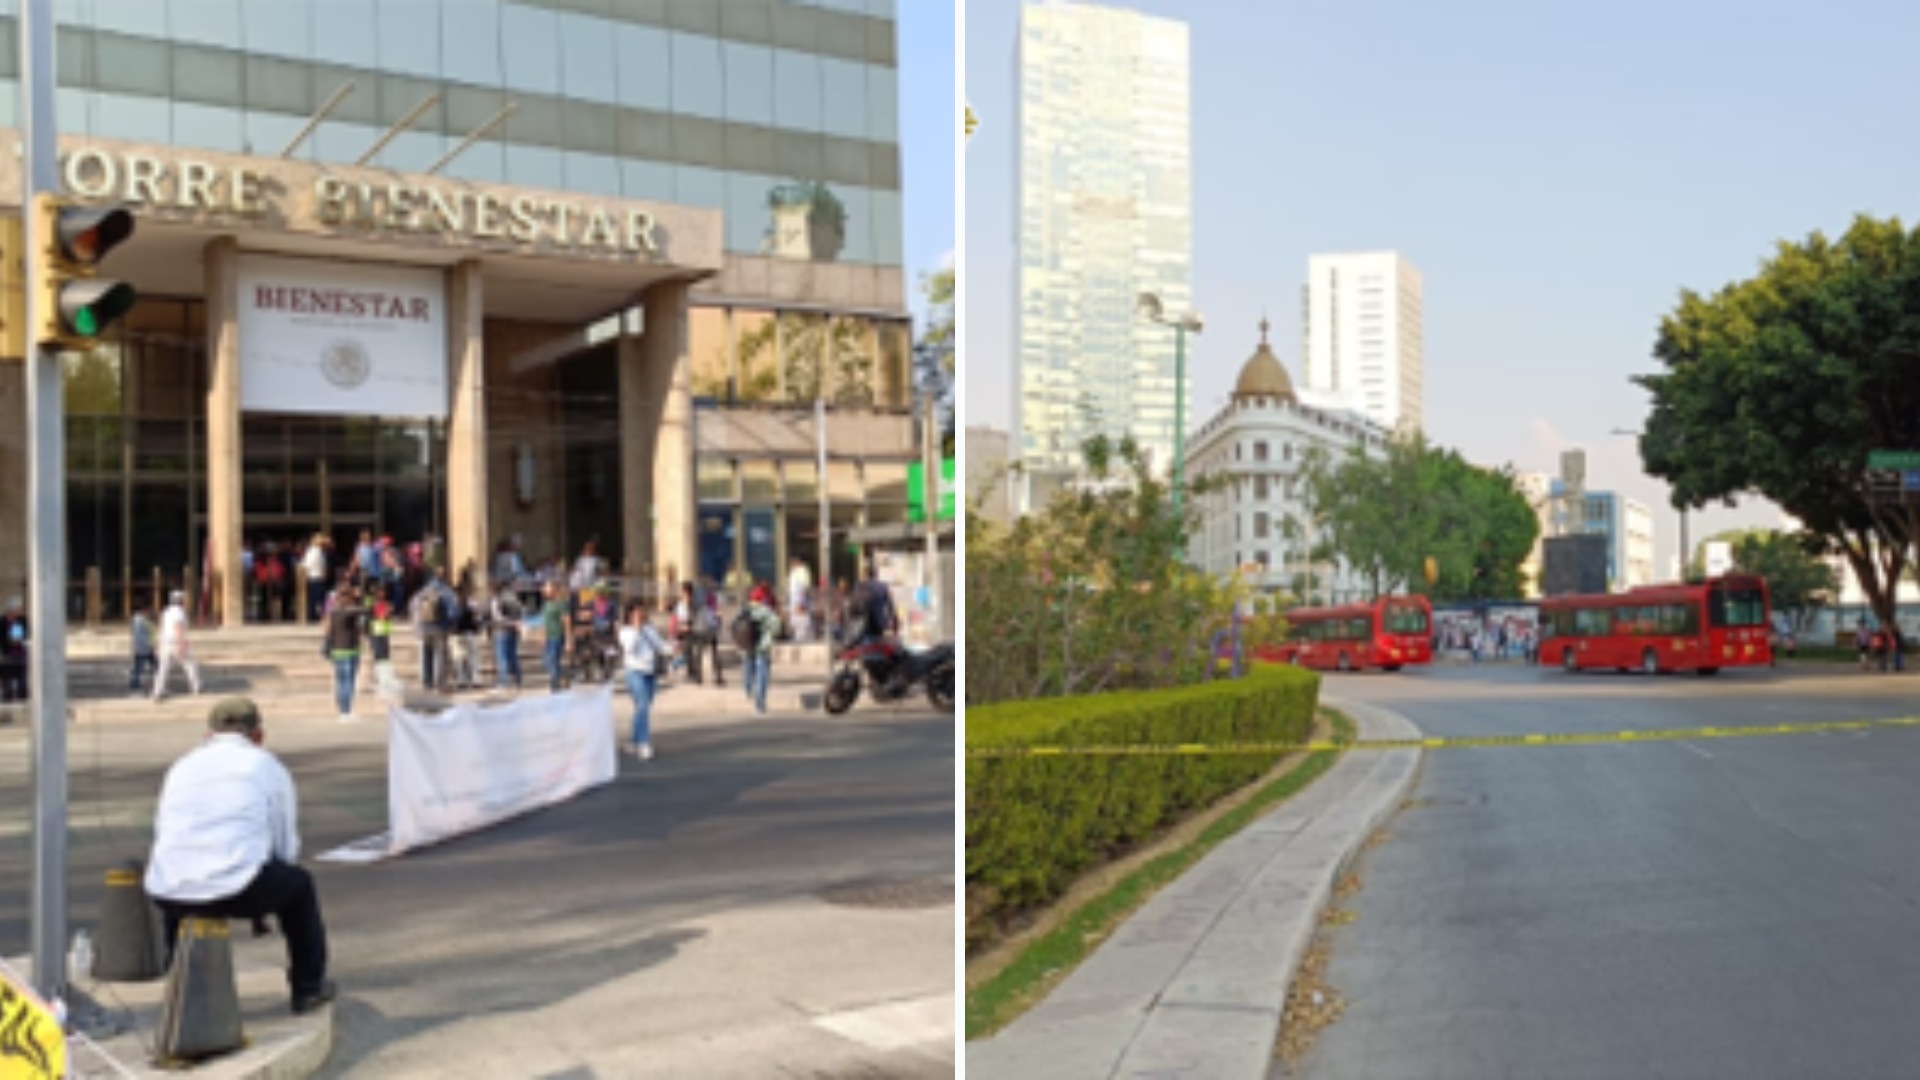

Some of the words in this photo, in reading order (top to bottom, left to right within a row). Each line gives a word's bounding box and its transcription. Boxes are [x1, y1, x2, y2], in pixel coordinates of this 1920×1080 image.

[14, 141, 268, 211] ORRE
[315, 177, 659, 250] BIENESTAR
[255, 284, 431, 322] BIENESTAR
